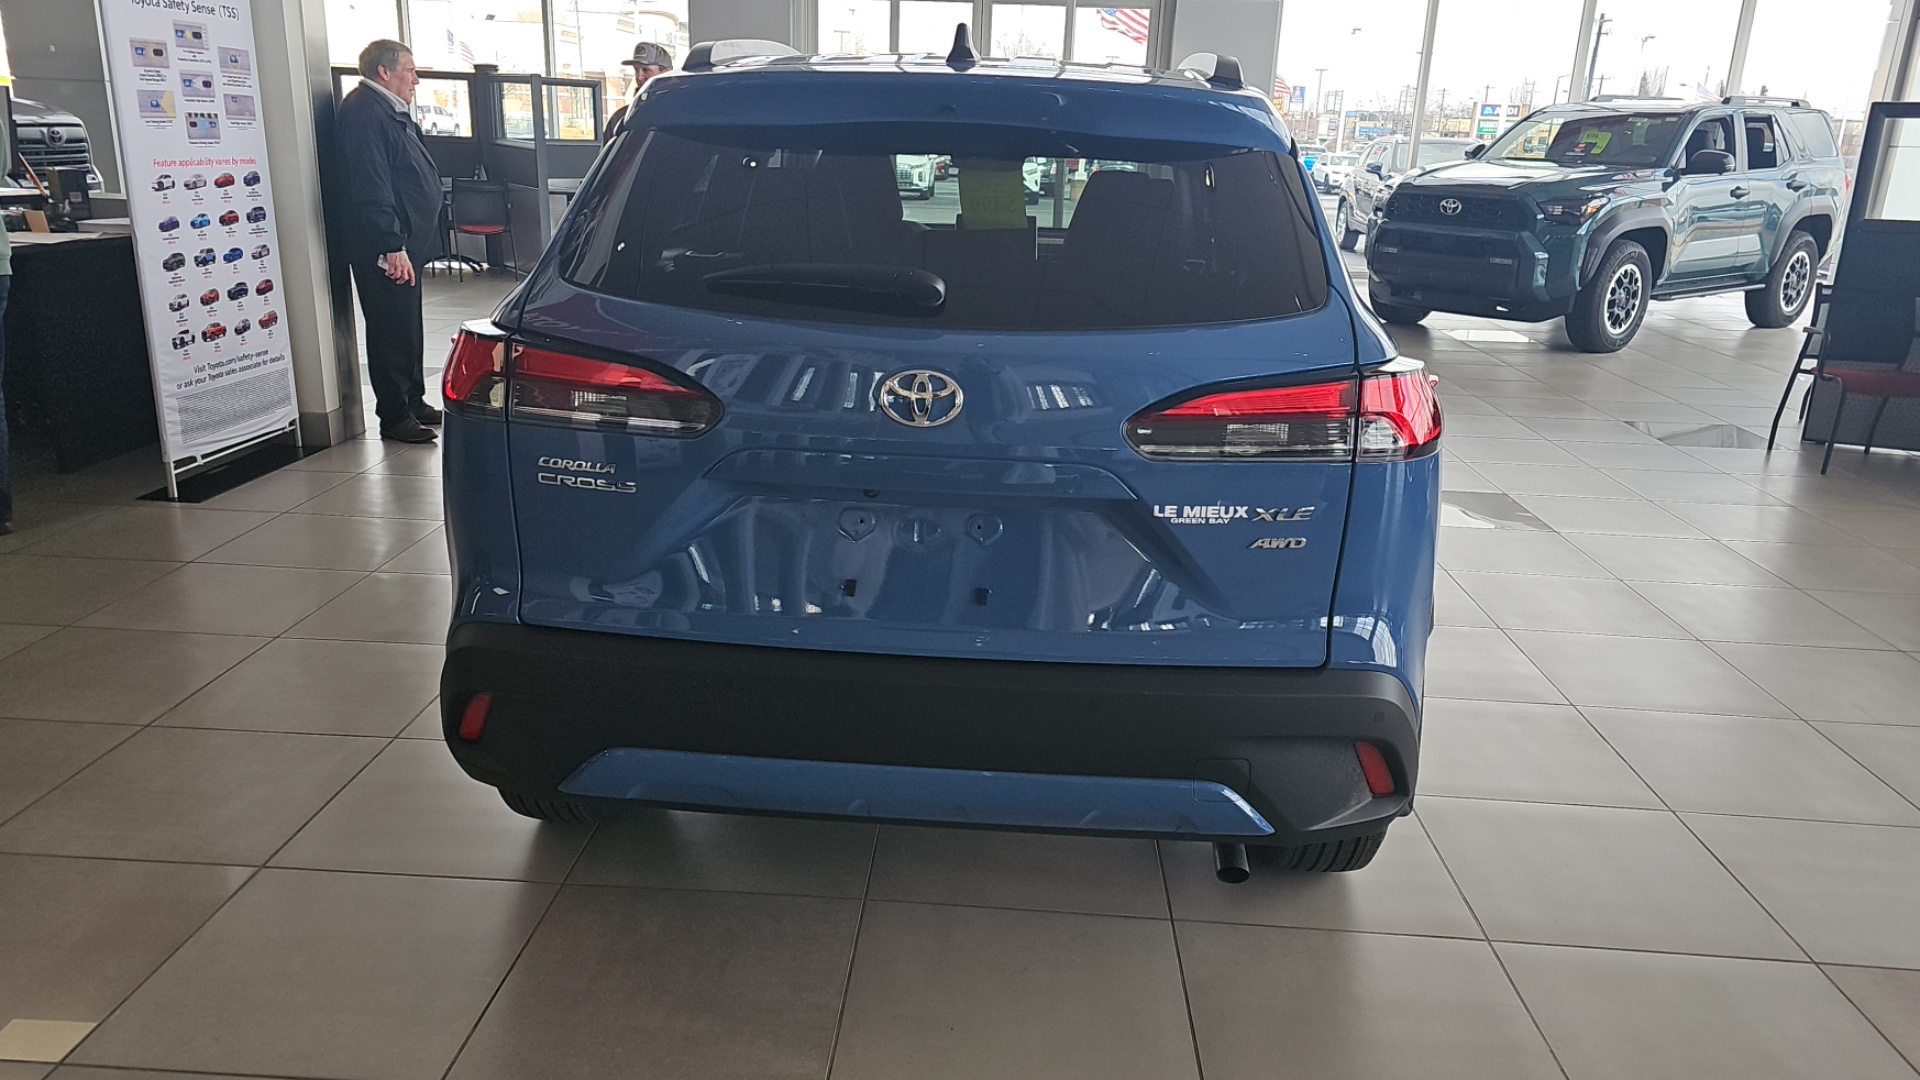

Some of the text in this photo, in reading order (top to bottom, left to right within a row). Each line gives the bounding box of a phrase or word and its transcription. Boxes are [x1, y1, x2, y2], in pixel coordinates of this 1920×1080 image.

[162, 0, 189, 14] Safety
[191, 1, 216, 15] Sense
[218, 4, 240, 21] (TSS)
[1494, 106, 1519, 116] ADI
[153, 156, 257, 168] Feature applicability varies by model
[176, 382, 184, 390] or
[184, 378, 194, 388] ask
[194, 376, 207, 387] your
[207, 371, 224, 382] Toyota
[224, 367, 238, 376] sales
[238, 361, 262, 373] associate
[268, 353, 286, 364] details
[193, 363, 207, 375] Visit
[537, 456, 617, 474] COROLLA
[537, 472, 638, 494] CROSS
[1153, 504, 1249, 519] LE MIEUX
[1251, 506, 1316, 522] XLE
[1170, 517, 1231, 525] GREEN BAY
[1249, 537, 1307, 549] AWD
